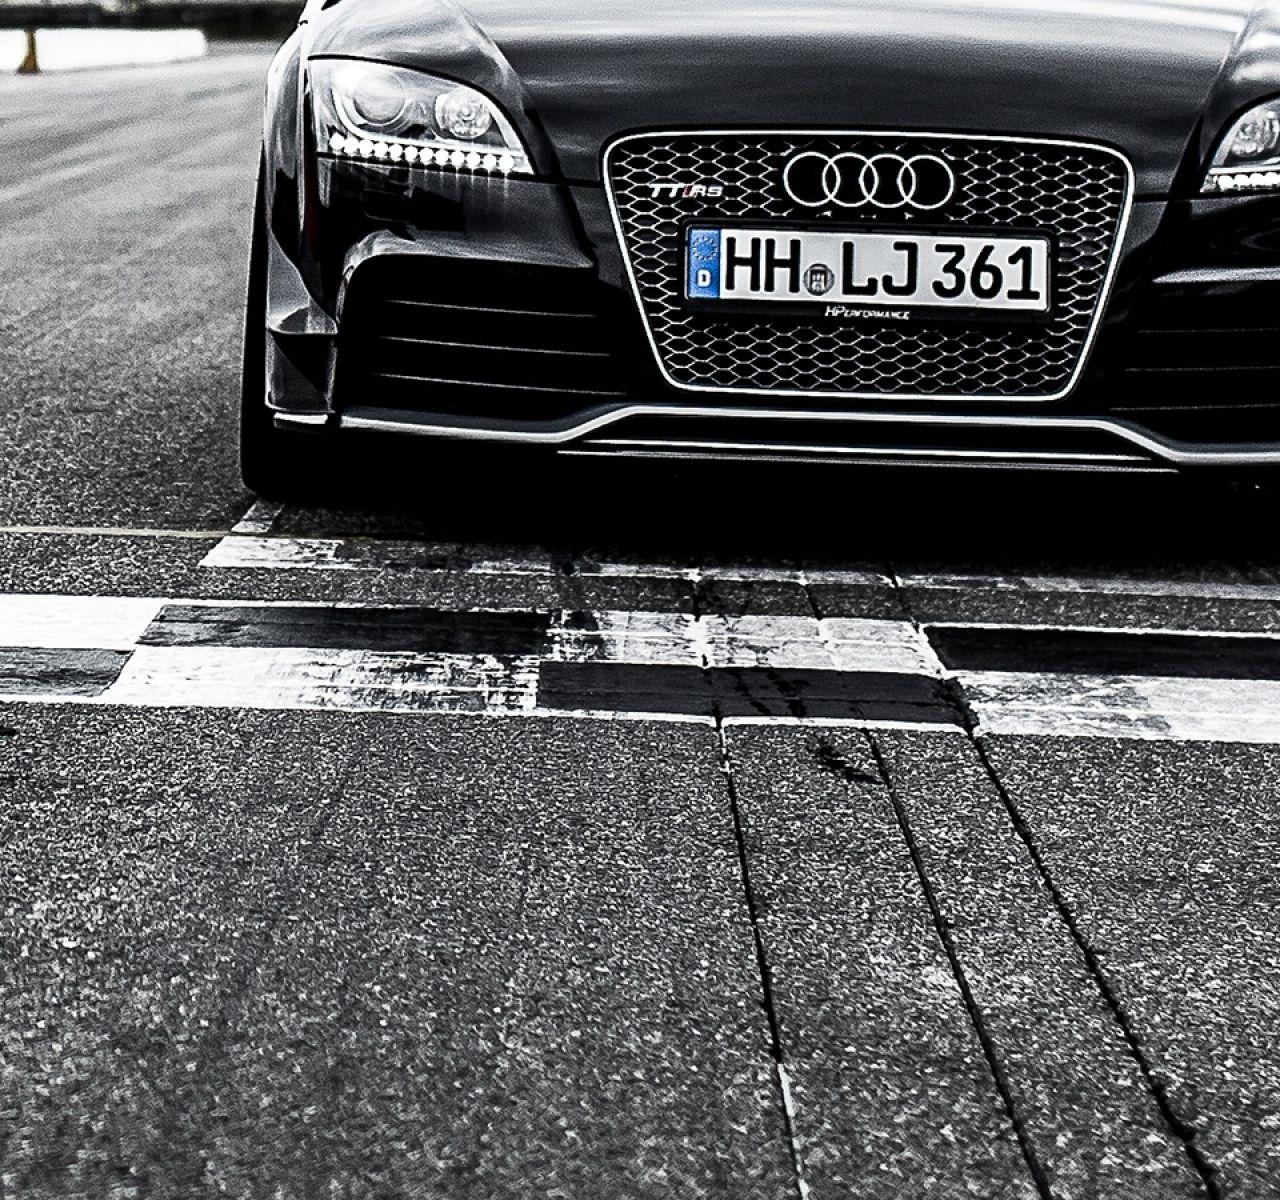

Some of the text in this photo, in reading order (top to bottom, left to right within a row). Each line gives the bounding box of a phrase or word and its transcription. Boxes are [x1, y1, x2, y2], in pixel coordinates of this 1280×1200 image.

[696, 268, 712, 288] D
[725, 237, 1041, 300] HH LJ 361
